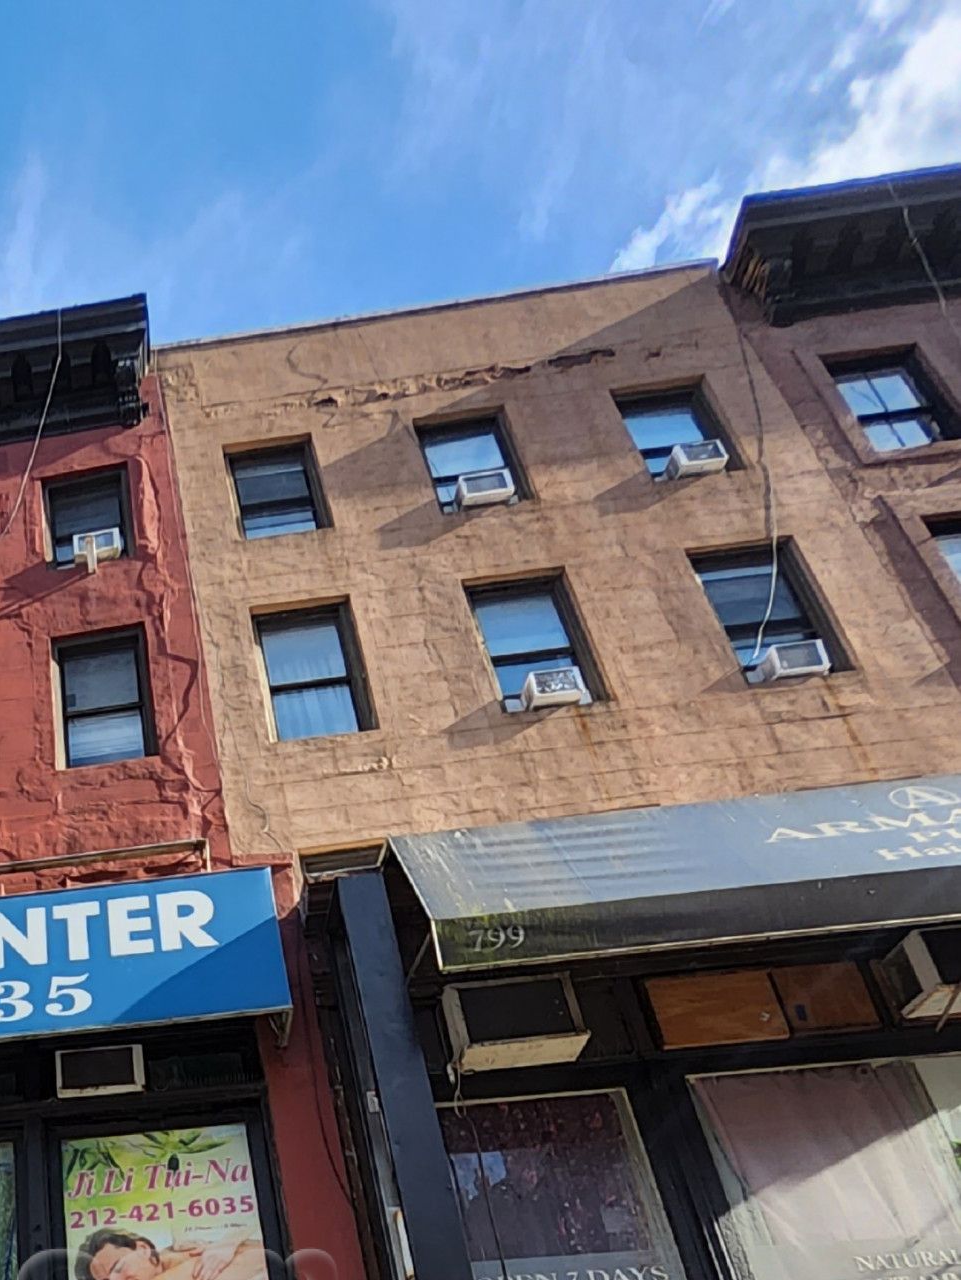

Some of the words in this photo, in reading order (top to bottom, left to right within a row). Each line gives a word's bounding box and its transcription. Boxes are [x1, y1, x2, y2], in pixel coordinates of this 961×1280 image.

[766, 809, 961, 843] ARM
[468, 925, 525, 951] 799
[68, 1170, 94, 1199] Ji
[102, 1167, 134, 1195] Li
[144, 1158, 249, 1190] Tui-Na
[70, 1195, 254, 1229] 212-421-6035
[854, 1250, 961, 1271] NATURAL
